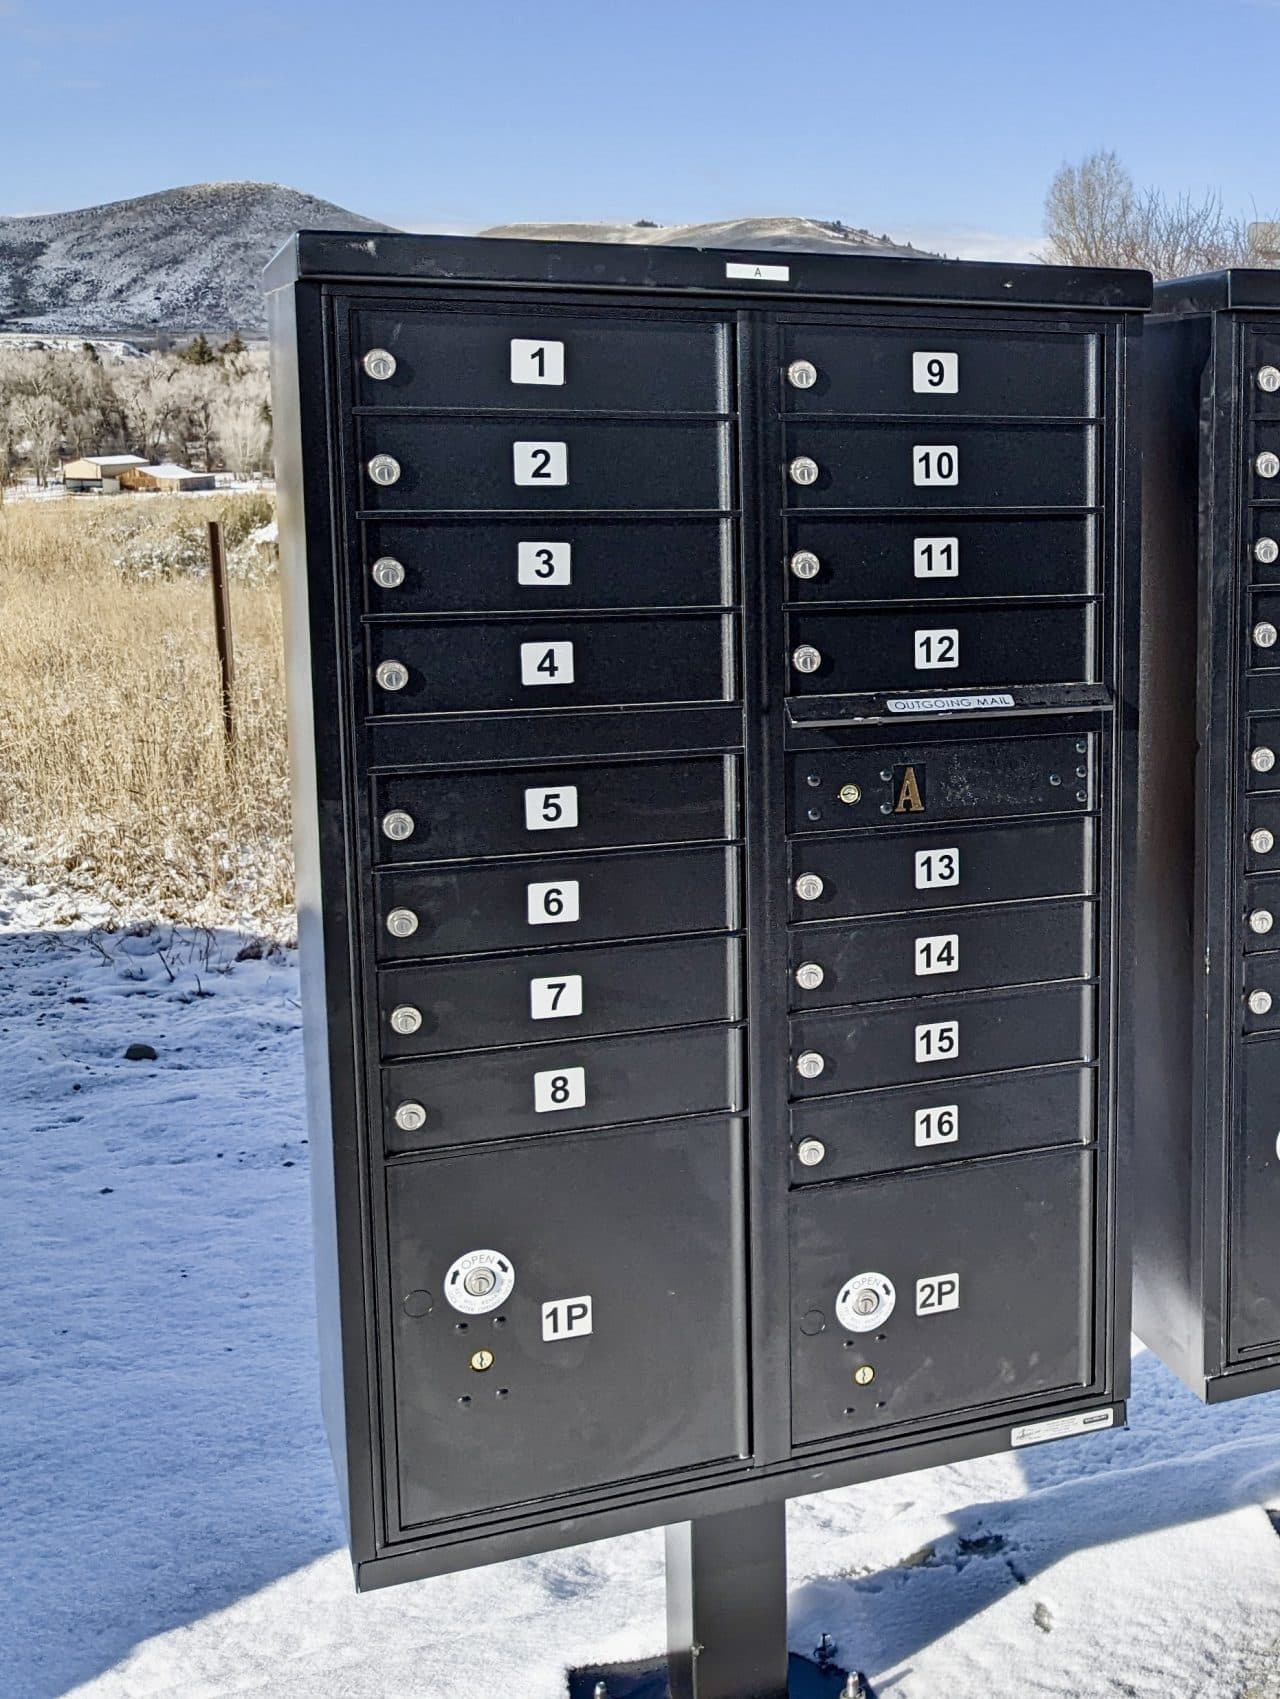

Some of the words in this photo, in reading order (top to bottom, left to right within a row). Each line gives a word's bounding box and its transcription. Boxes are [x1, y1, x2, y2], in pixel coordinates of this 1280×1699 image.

[754, 267, 762, 278] A
[530, 347, 545, 378] 1
[926, 358, 945, 387] 9
[530, 448, 552, 479] 2
[918, 451, 954, 480] 10
[534, 548, 555, 579] 3
[920, 543, 953, 572] 11
[536, 648, 559, 678] 4
[919, 635, 955, 664] 12
[894, 698, 972, 711] OUTGOING
[976, 697, 1010, 706] MAIL
[894, 766, 925, 813] A
[542, 793, 563, 822] 5
[920, 854, 955, 882] 13
[543, 888, 564, 917] 6
[919, 940, 955, 969] 14
[547, 982, 567, 1011] 7
[919, 1027, 954, 1056] 15
[550, 1075, 570, 1104] 8
[919, 1110, 954, 1139] 16
[461, 1254, 496, 1270] OPEN
[851, 1276, 881, 1290] OPEN
[919, 1280, 956, 1309] 2P
[545, 1303, 588, 1334] 1P
